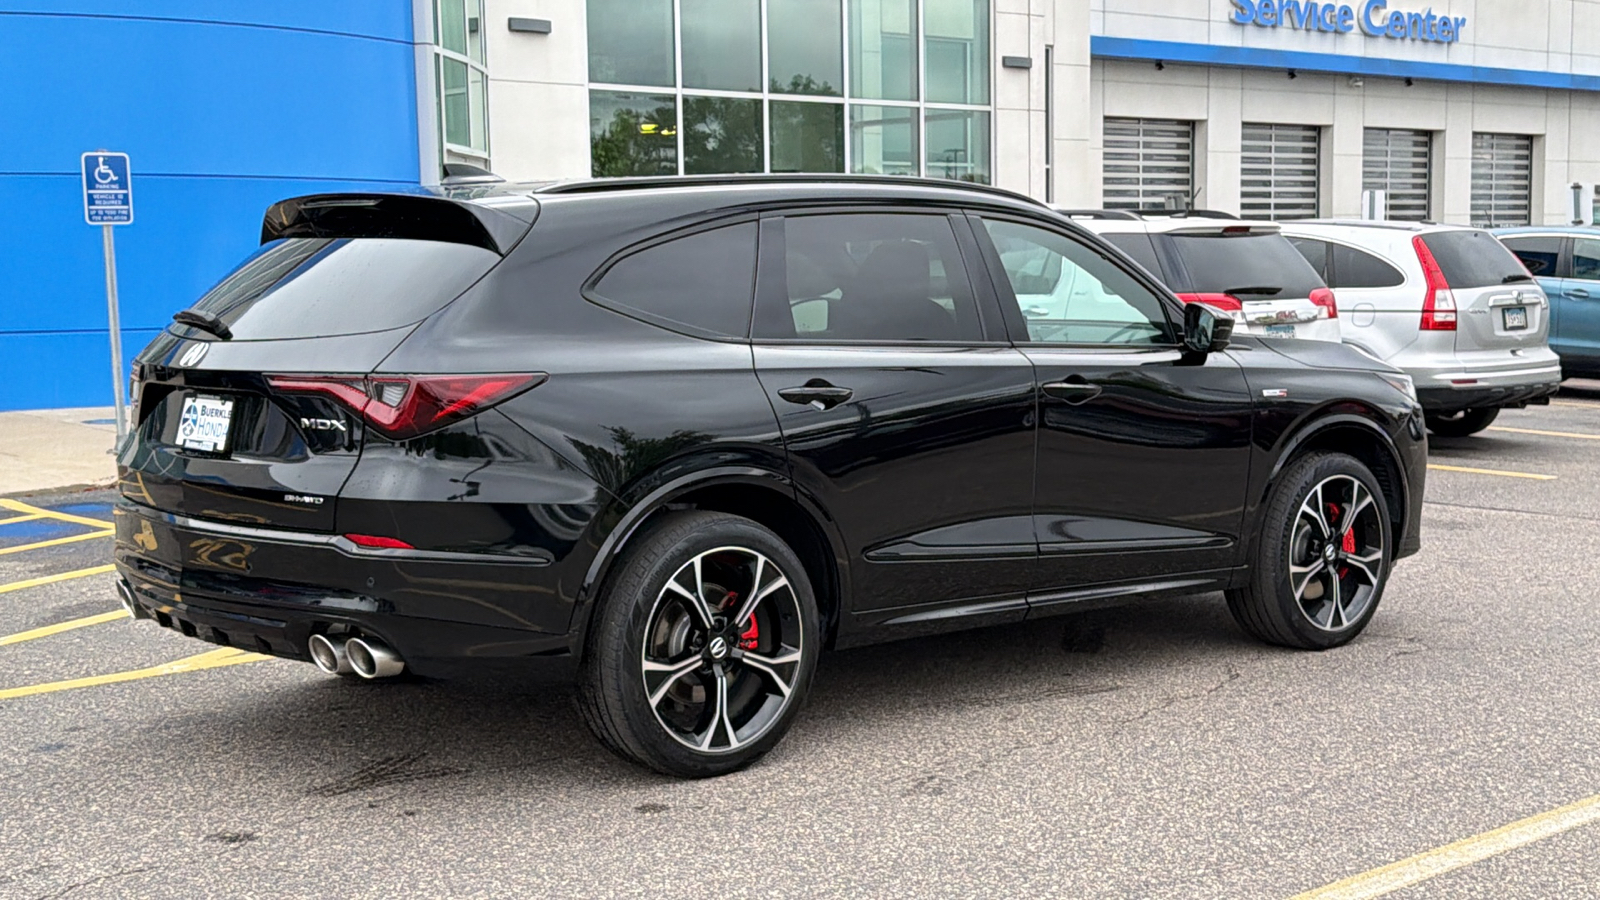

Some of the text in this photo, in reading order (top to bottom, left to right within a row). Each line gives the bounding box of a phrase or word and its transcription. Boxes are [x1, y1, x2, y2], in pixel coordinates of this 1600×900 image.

[1231, 0, 1466, 43] Service Center
[197, 417, 229, 437] HONDA
[301, 417, 347, 431] MDX
